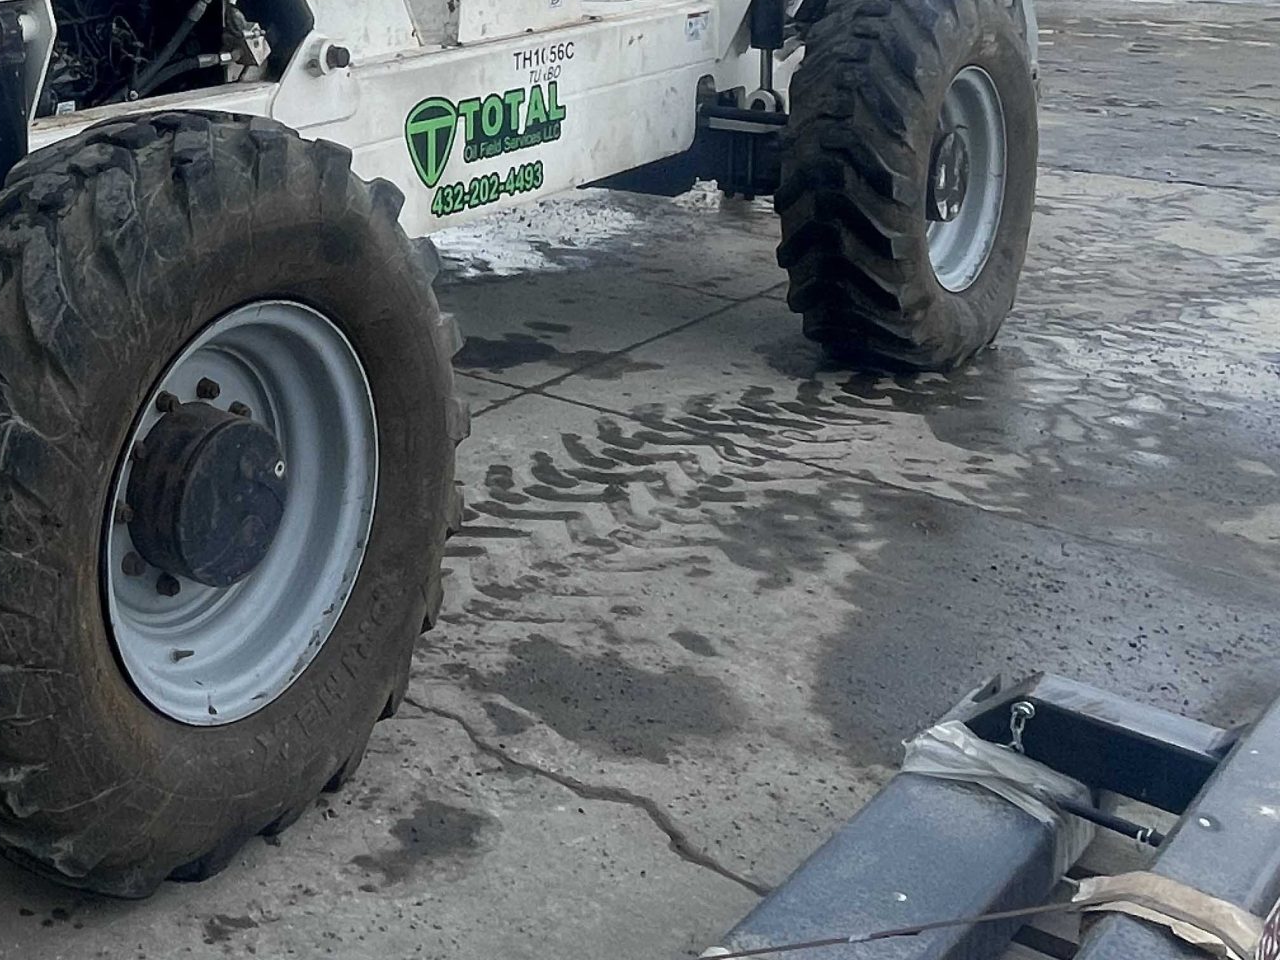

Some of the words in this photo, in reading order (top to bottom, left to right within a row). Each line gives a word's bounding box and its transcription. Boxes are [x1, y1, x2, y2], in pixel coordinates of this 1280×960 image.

[529, 64, 561, 84] TUBO
[458, 81, 566, 141] TOTAL
[479, 141, 502, 159] Field
[503, 135, 541, 153] Services
[542, 123, 561, 142] LLC
[431, 161, 543, 216] 432-202-4493
